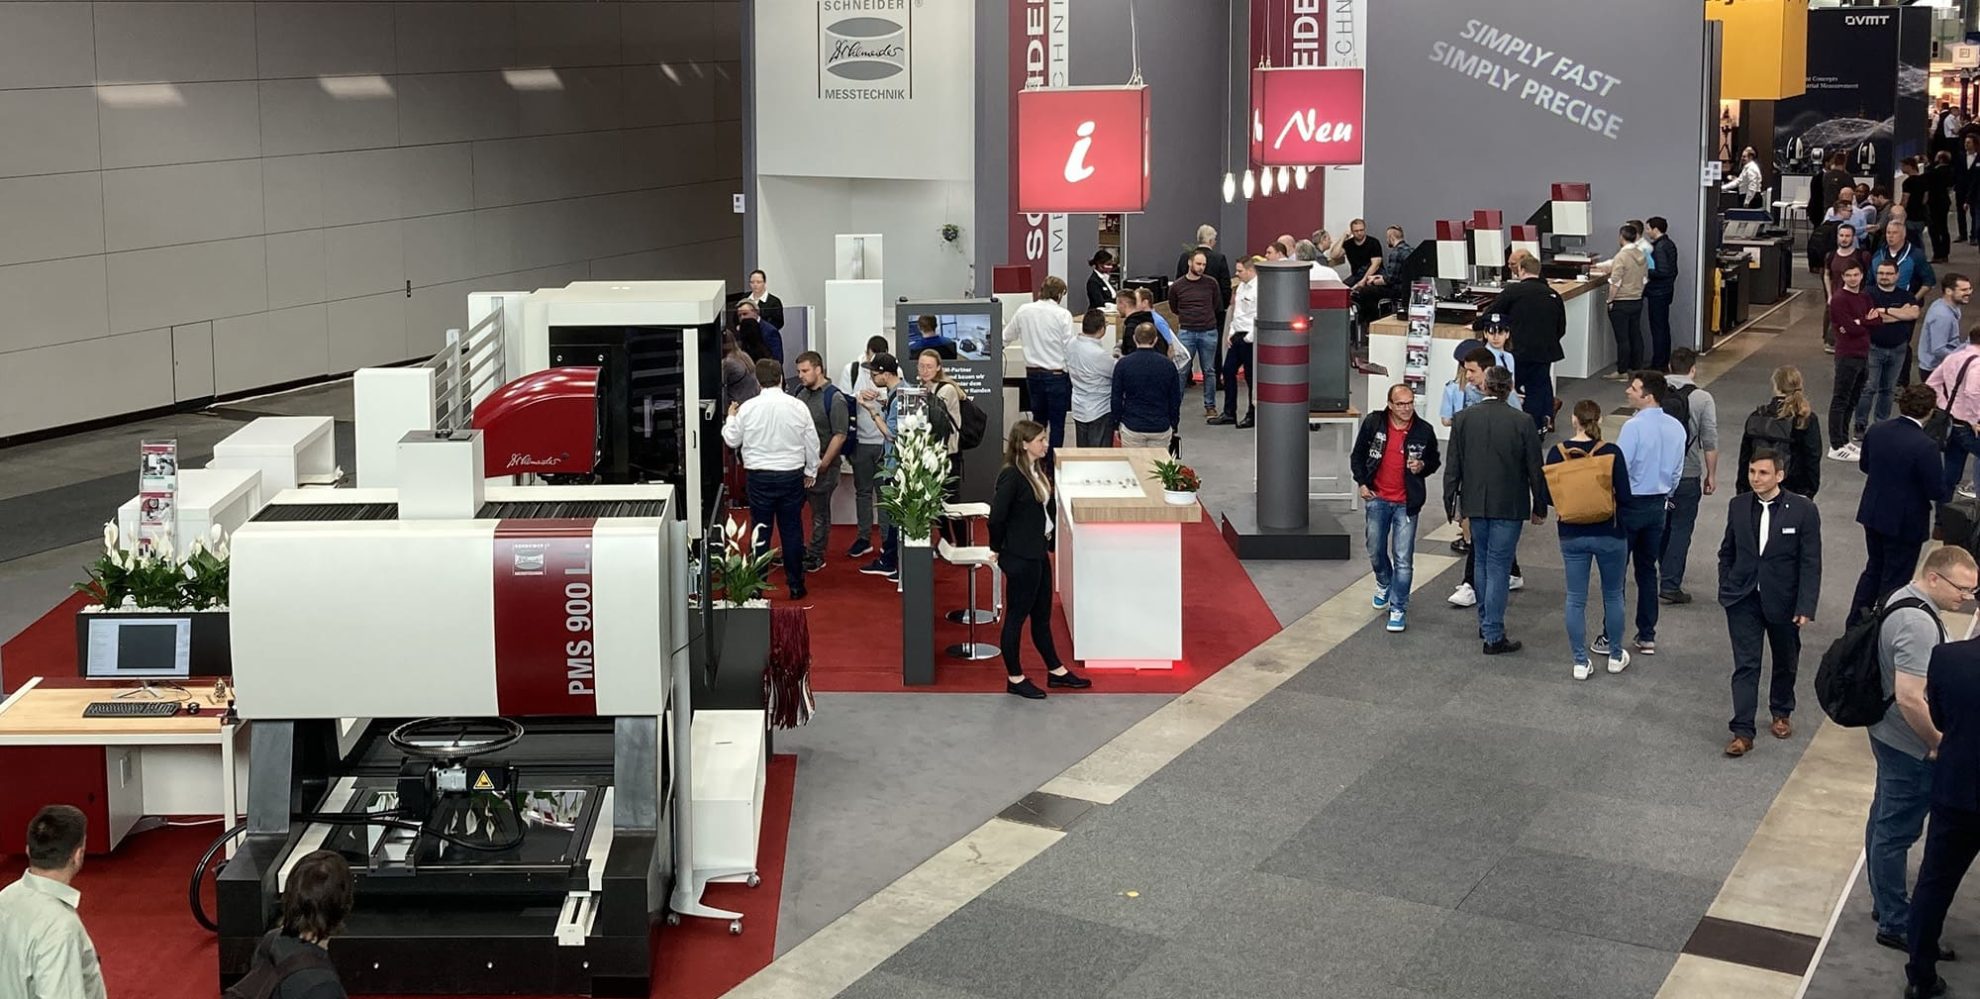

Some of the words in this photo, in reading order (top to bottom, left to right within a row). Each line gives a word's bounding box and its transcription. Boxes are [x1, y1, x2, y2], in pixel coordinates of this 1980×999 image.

[824, 0, 904, 11] SCHNEIDER
[1459, 19, 1554, 68] SIMPLY
[1551, 57, 1621, 97] FAST
[825, 89, 905, 100] MESSTECHNIK
[1428, 41, 1520, 91] SIMPLY
[1520, 79, 1623, 139] PRECISE
[1064, 120, 1096, 183] i
[1273, 108, 1353, 149] Neu
[565, 583, 592, 632] 900
[566, 640, 594, 695] PMS
